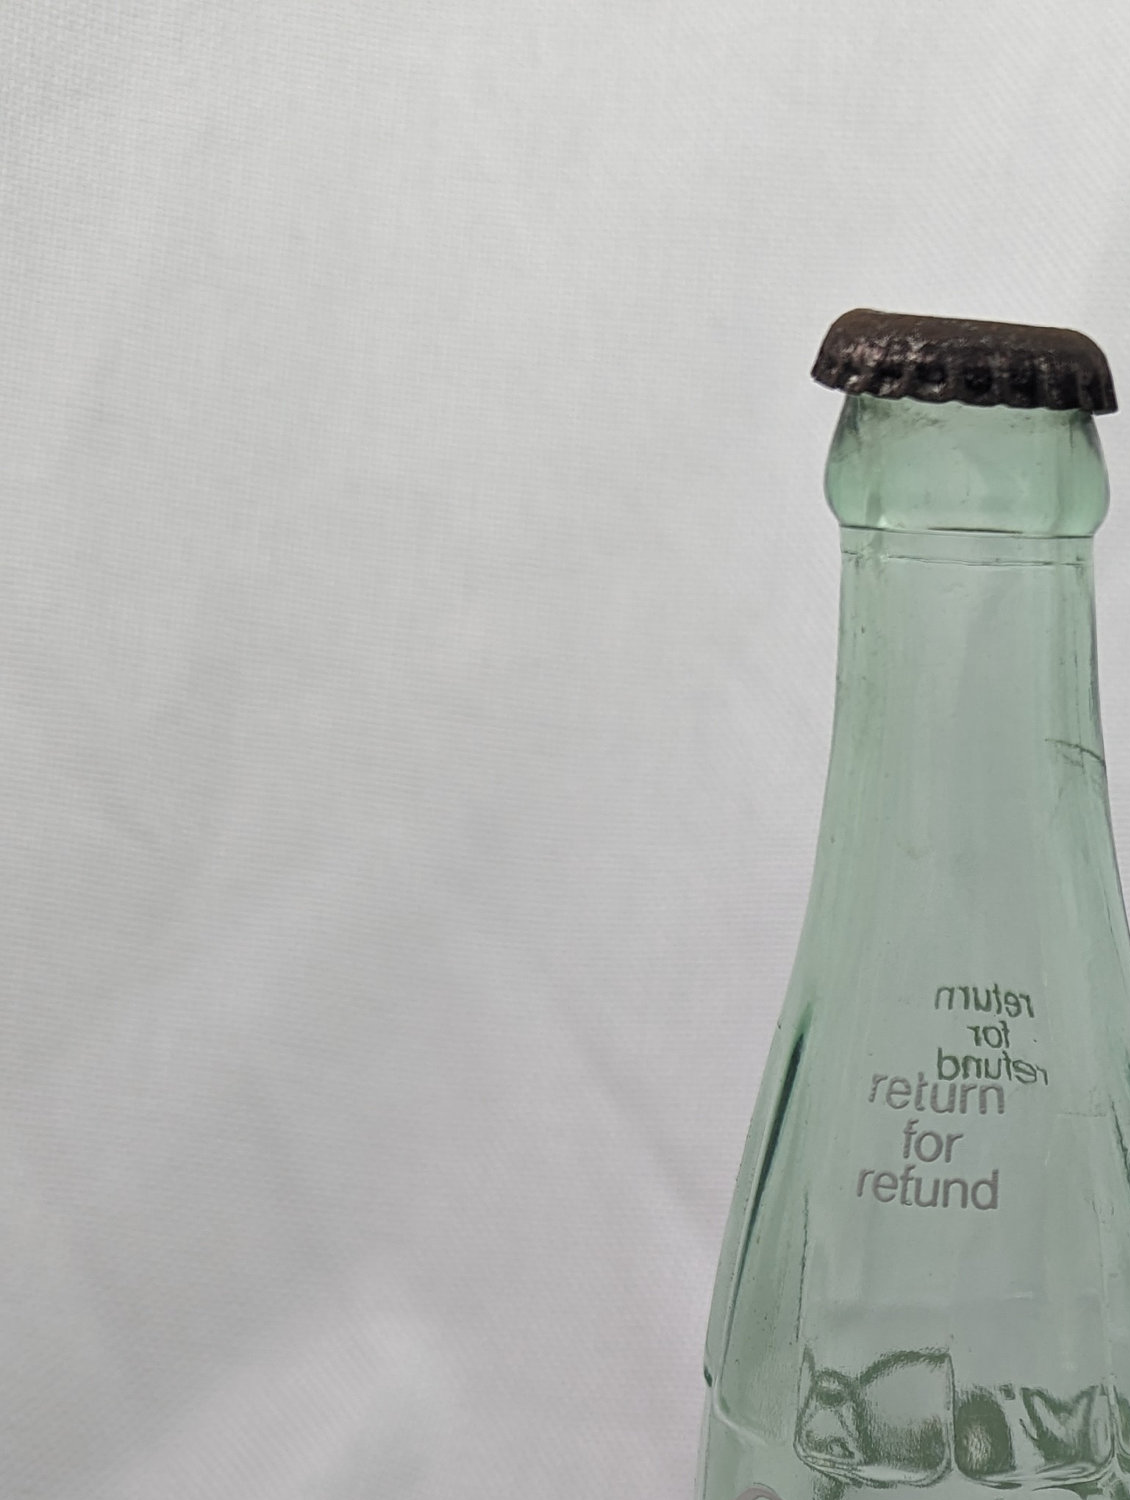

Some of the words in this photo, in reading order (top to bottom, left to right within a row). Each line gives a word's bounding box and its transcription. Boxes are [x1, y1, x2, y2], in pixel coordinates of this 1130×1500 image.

[868, 1072, 1005, 1115] return
[903, 1118, 963, 1163] for
[856, 1164, 999, 1210] refund
